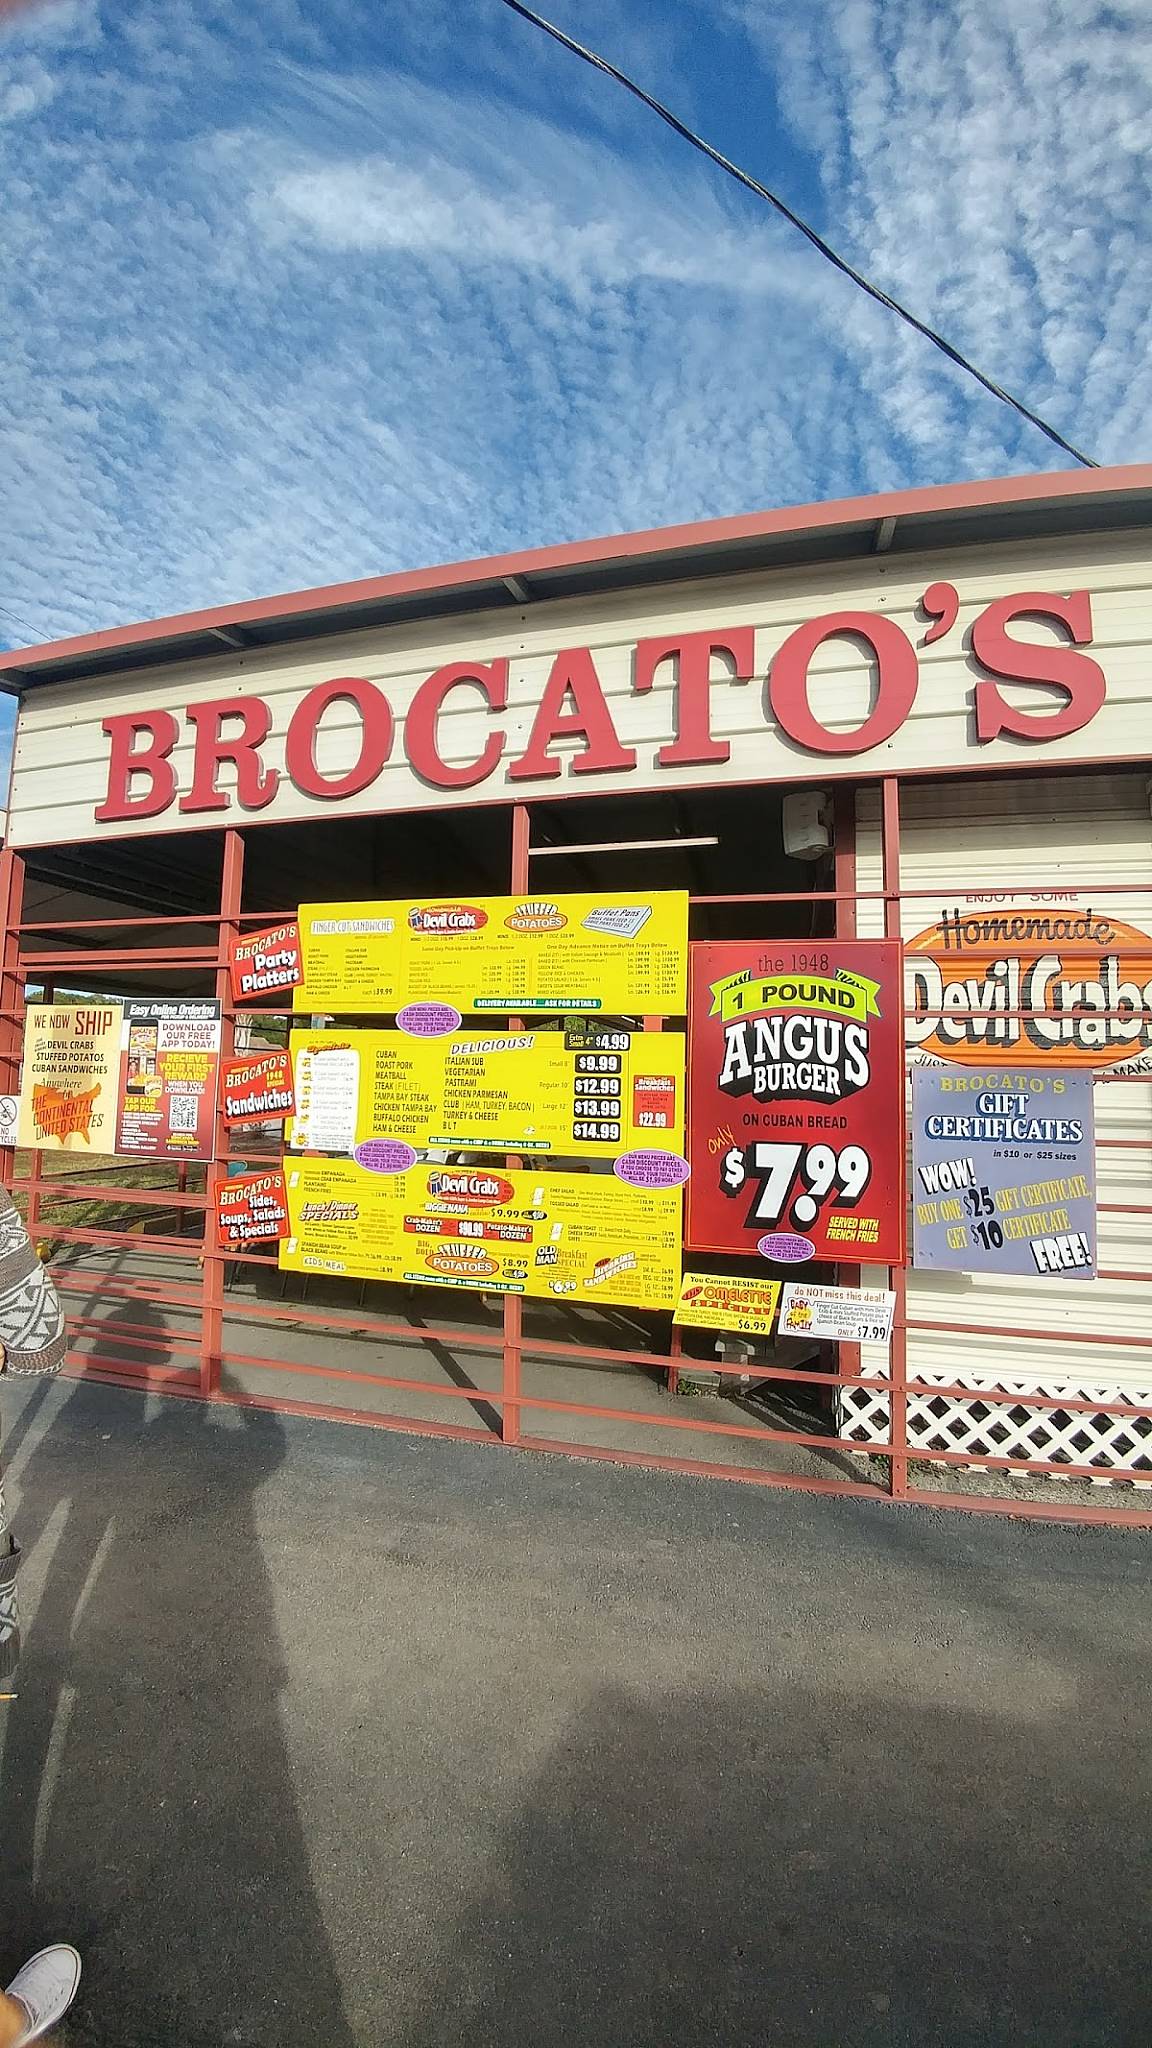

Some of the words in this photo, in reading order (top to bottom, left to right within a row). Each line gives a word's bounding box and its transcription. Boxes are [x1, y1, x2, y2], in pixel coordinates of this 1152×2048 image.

[95, 582, 1106, 821] BROCATO'S
[515, 903, 558, 916] STUFFED
[591, 909, 618, 917] Buffet
[620, 909, 641, 917] Pans
[313, 922, 335, 933] FINGER
[352, 920, 393, 931] SANDWICHES
[423, 912, 447, 927] Devil
[449, 912, 476, 928] Crabs
[511, 918, 562, 929] POTATOES
[937, 908, 1116, 951] Homemade
[235, 926, 297, 961] BROCATO'S
[255, 950, 297, 971] Party
[759, 955, 784, 972] the
[791, 954, 829, 972] 1948
[242, 968, 299, 992] Platters
[732, 992, 743, 1009] 1
[762, 984, 855, 1009] POUND
[905, 955, 1020, 1042] Devil
[130, 1004, 150, 1017] Easy
[150, 1004, 178, 1015] Online
[179, 1005, 216, 1018] Ordering
[34, 1015, 47, 1029] WE
[49, 1014, 70, 1029] NOW
[75, 1011, 113, 1036] SHIP
[162, 1023, 216, 1031] DOWNLOAD
[187, 1032, 211, 1040] FREE
[596, 1034, 629, 1050] $4.99
[47, 1041, 68, 1049] DEVIL
[70, 1041, 94, 1050] CRABS
[181, 1040, 216, 1048] TODAY!
[451, 1036, 534, 1054] DELICIOUS!
[719, 1015, 870, 1087] ANGUS
[36, 1053, 67, 1061] STUFFED
[69, 1053, 104, 1062] POTATOS
[166, 1054, 208, 1064] RECIEVE
[444, 1057, 470, 1066] ITALIAN
[471, 1058, 484, 1066] SUB
[579, 1056, 618, 1071] $9.99
[32, 1064, 56, 1073] CUBAN
[58, 1064, 108, 1074] SANDWICHES
[159, 1063, 187, 1072] YOUR
[187, 1063, 215, 1073] FIRST
[226, 1056, 287, 1088] BROCATO'S
[376, 1061, 395, 1069] ROAST
[396, 1062, 413, 1070] PORK
[444, 1068, 485, 1077] VEGETARIAN
[164, 1072, 207, 1081] REWARD
[375, 1072, 406, 1080] MEATBALL
[445, 1079, 477, 1087] PASTRAMI
[753, 1062, 841, 1097] BURGER
[41, 1078, 82, 1089] Anywhere
[375, 1082, 393, 1090] STEAK
[575, 1079, 619, 1094] $12.99
[940, 1075, 1065, 1093] BROCATO'S
[374, 1092, 395, 1100] TAMPA
[410, 1093, 429, 1102] STEAK
[443, 1089, 471, 1098] CHICKEN
[472, 1090, 508, 1099] PARMESAN
[32, 1094, 47, 1111] THE
[227, 1088, 293, 1116] Sandwiches
[374, 1103, 400, 1111] CHICKEN
[402, 1103, 423, 1112] TAMPA
[424, 1104, 437, 1112] BAY
[443, 1100, 459, 1108] CLUB
[575, 1100, 620, 1116] $13.99
[979, 1093, 1030, 1116] GIFT
[33, 1099, 94, 1126] CONTINENTAL
[374, 1113, 401, 1122] BUFFALO
[401, 1114, 429, 1123] CHICKEN
[443, 1111, 467, 1120] TURKEY
[474, 1112, 499, 1121] CHEESE
[639, 1112, 666, 1127] $22.99
[36, 1120, 67, 1141] UNITED
[69, 1113, 104, 1132] STATES
[373, 1124, 387, 1132] HAM
[393, 1125, 417, 1133] CHEESE
[743, 1114, 759, 1126] ON
[762, 1114, 804, 1128] CUBAN
[807, 1116, 848, 1129] BREAD
[0, 1127, 10, 1135] NO
[574, 1123, 620, 1139] $14.99
[927, 1116, 1083, 1143] CERTIFICATES
[707, 1124, 737, 1154] only
[993, 1149, 1002, 1158] in
[1003, 1149, 1020, 1159] $10
[1023, 1151, 1033, 1159] or
[1036, 1151, 1053, 1160] $25
[1054, 1152, 1077, 1161] sizes
[724, 1143, 870, 1222] $7.99
[918, 1157, 977, 1195] WOW!
[220, 1176, 282, 1206] BROCATO'S
[442, 1175, 468, 1192] Devil
[469, 1177, 499, 1195] Crabs
[249, 1195, 277, 1208] Sides,
[917, 1203, 940, 1226] BUY
[940, 1198, 965, 1222] ONE
[963, 1186, 995, 1218] $25
[995, 1187, 1022, 1213] GIFT
[221, 1213, 252, 1225] Soups,
[253, 1206, 286, 1221] Salads
[299, 1211, 359, 1221] SPECIALS
[491, 1209, 519, 1218] $9.99
[230, 1226, 239, 1239] &
[239, 1222, 279, 1238] Specials
[415, 1224, 440, 1233] DOZEN
[829, 1216, 859, 1229] SERVED
[859, 1218, 880, 1232] WITH
[947, 1226, 968, 1249] GET
[970, 1220, 1003, 1250] $10
[1002, 1209, 1072, 1240] CERTIFICATE
[500, 1231, 527, 1240] DOZEN
[826, 1228, 857, 1242] FRENCH
[857, 1230, 880, 1244] FRIES
[438, 1243, 488, 1260] STUFFED
[538, 1245, 556, 1256] OLD
[558, 1249, 588, 1260] Breakfast
[1030, 1232, 1093, 1273] FREE!
[304, 1257, 323, 1266] KIDS
[325, 1260, 345, 1270] MEAL
[433, 1258, 493, 1272] POTATOES
[503, 1258, 528, 1268] $8.99
[536, 1254, 558, 1265] MAN
[549, 1280, 577, 1294] $6.99
[705, 1277, 730, 1286] Cannot
[732, 1280, 759, 1289] RESIST
[704, 1286, 772, 1305] OMELETTE
[794, 1286, 804, 1296] do
[806, 1288, 824, 1298] NOT
[846, 1292, 862, 1302] this
[863, 1293, 885, 1304] deal!
[791, 1299, 809, 1311] BABY
[738, 1319, 767, 1331] $6.99
[838, 1328, 854, 1336] ONLY
[857, 1325, 886, 1339] $7.99
